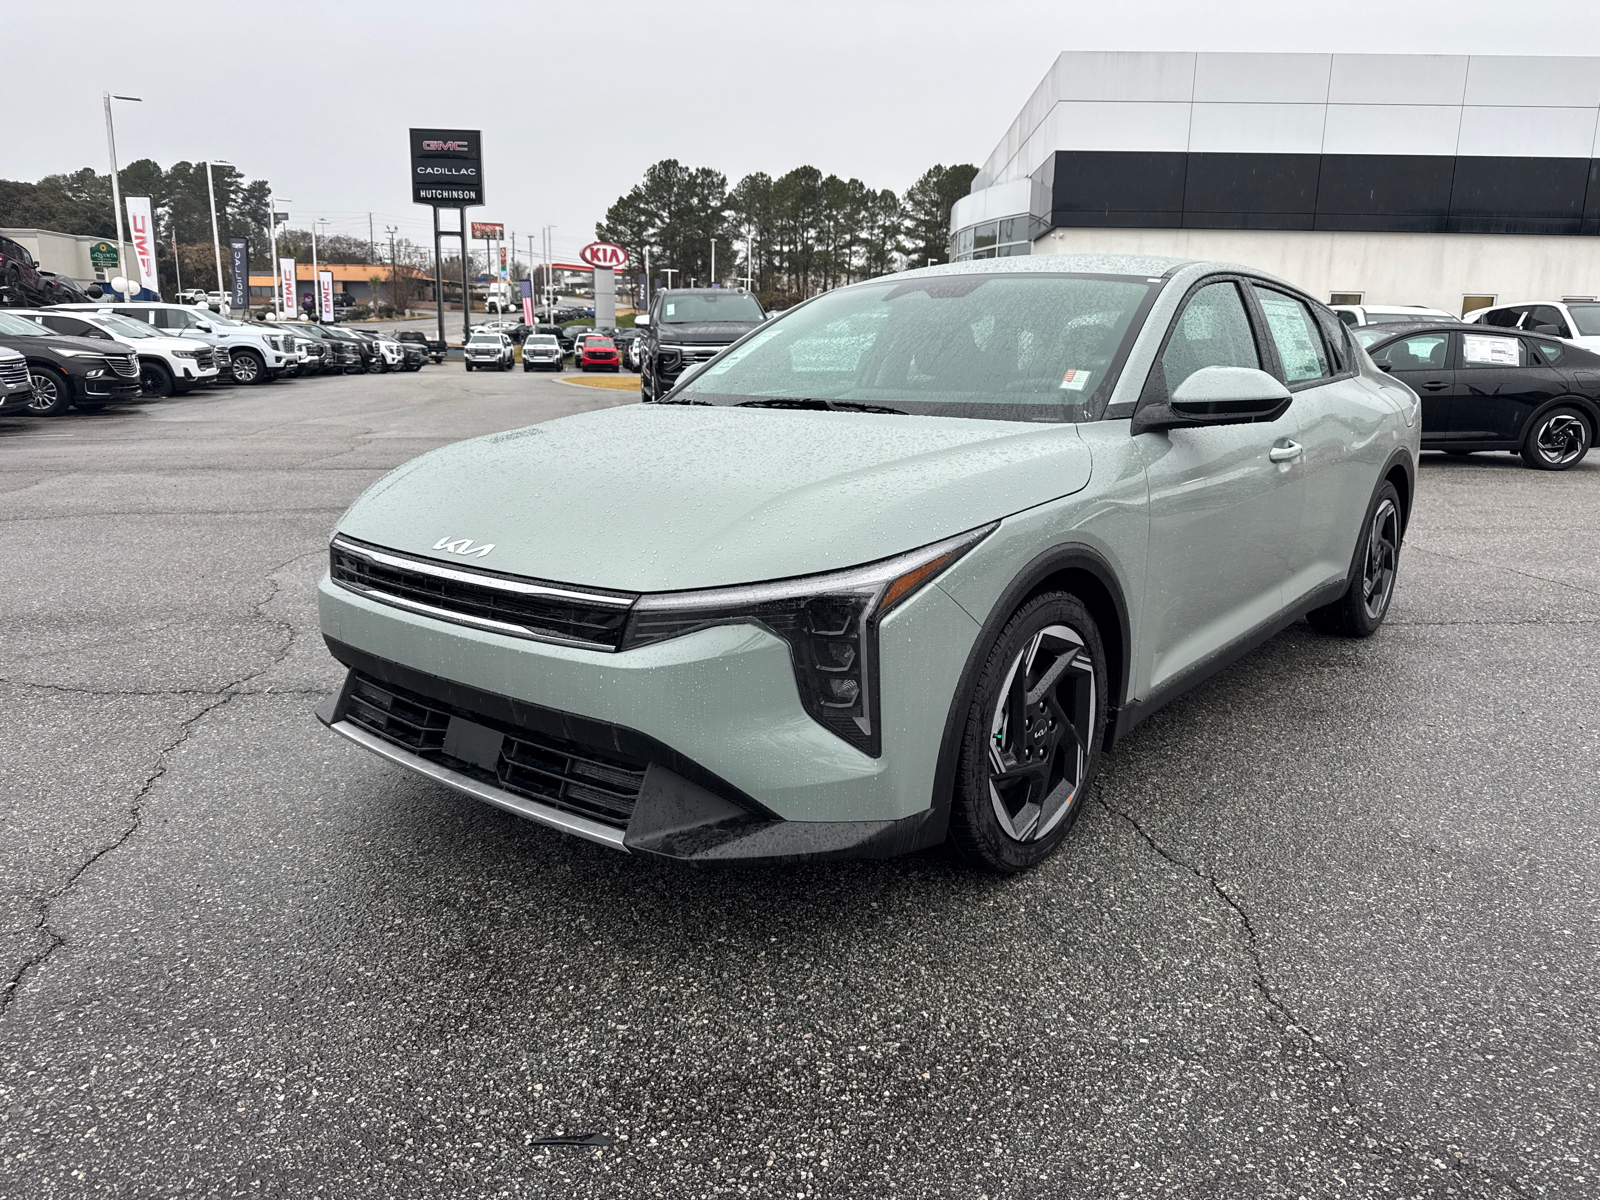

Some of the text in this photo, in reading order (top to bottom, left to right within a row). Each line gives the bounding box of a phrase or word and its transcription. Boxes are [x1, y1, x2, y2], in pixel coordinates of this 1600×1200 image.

[422, 140, 469, 151] GMC
[417, 166, 476, 176] CADILLAC
[420, 189, 476, 199] HUTCHINSON
[589, 247, 621, 263] KIA
[432, 535, 497, 559] KIA
